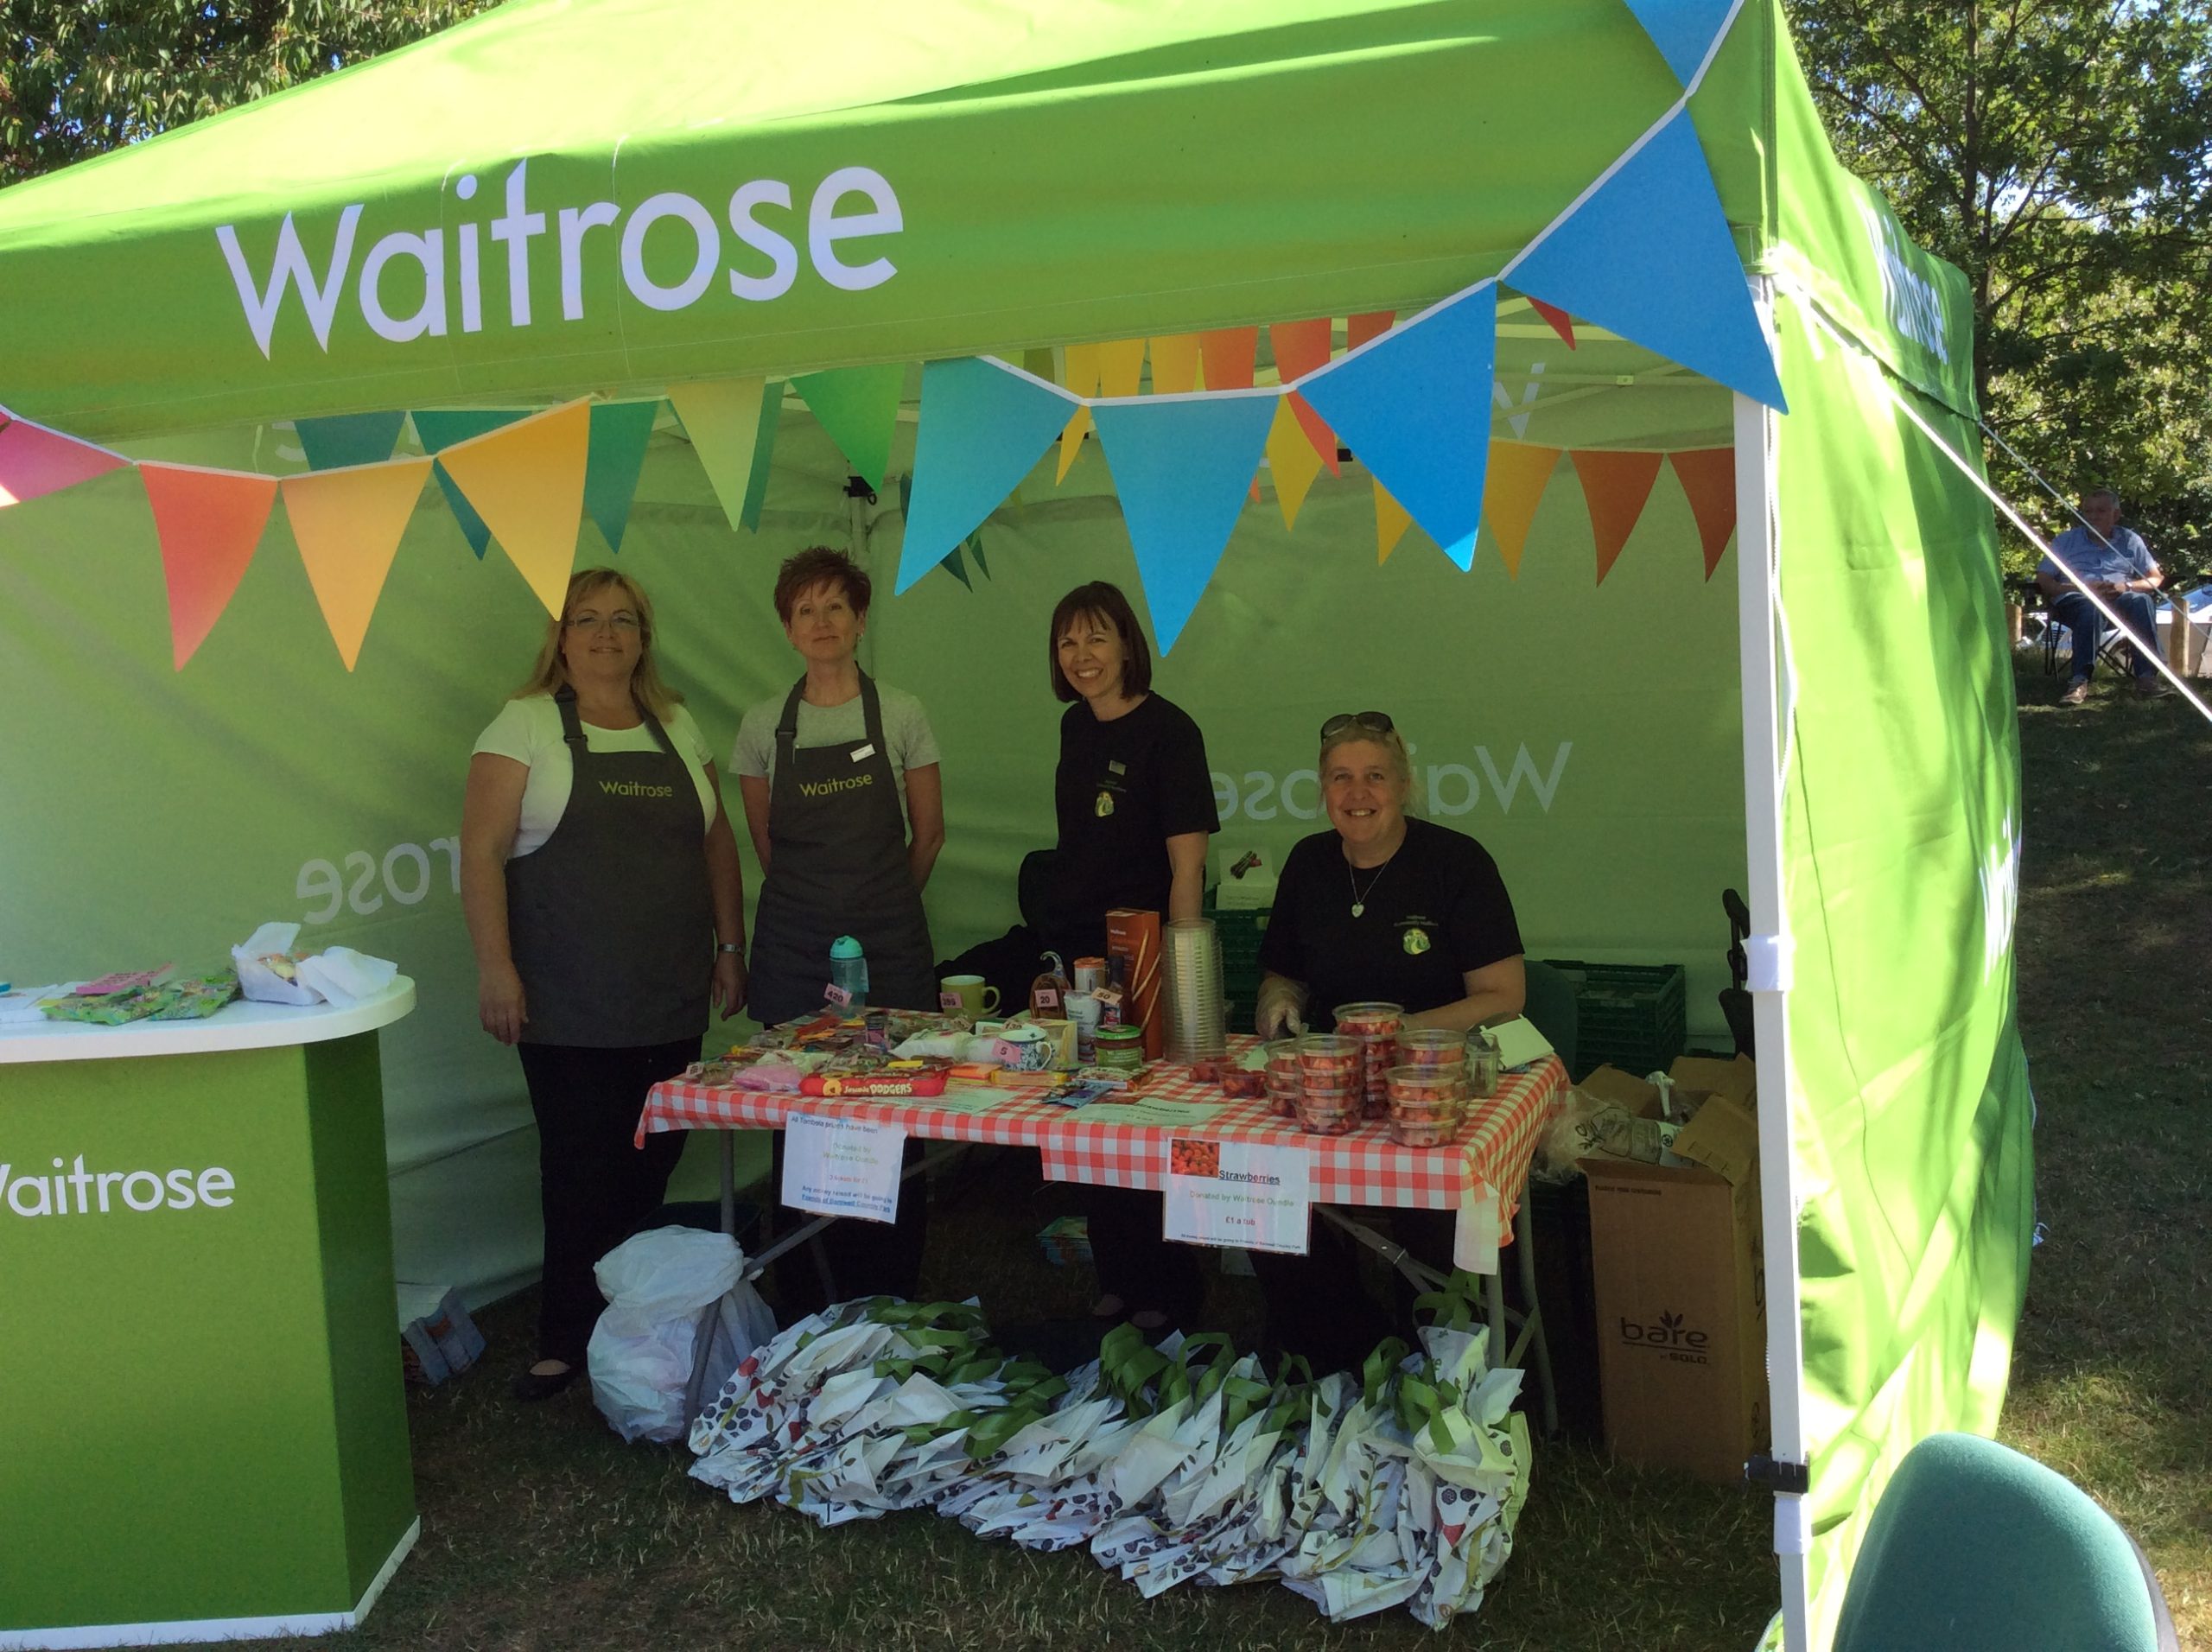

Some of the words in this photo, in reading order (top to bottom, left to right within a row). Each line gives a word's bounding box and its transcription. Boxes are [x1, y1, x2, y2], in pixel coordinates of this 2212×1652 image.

[215, 157, 904, 361] Waitrose
[598, 780, 673, 797] Waitrose
[799, 773, 873, 797] Waitrose
[827, 990, 844, 1002] 420
[1040, 995, 1050, 1004] 20
[1000, 1046, 1008, 1055] 5
[869, 1083, 912, 1095] DODGERS
[800, 1117, 824, 1128] Tombola
[1218, 1169, 1281, 1185] Strawberries
[0, 1154, 235, 1217] aitrose
[1190, 1190, 1219, 1201] Donated
[1221, 1191, 1230, 1203] by
[1233, 1194, 1265, 1204] Waitrose
[1225, 1216, 1235, 1224] £1
[1243, 1217, 1255, 1226] tub
[1620, 1316, 1708, 1349] bare
[1669, 1353, 1707, 1364] SOLO
